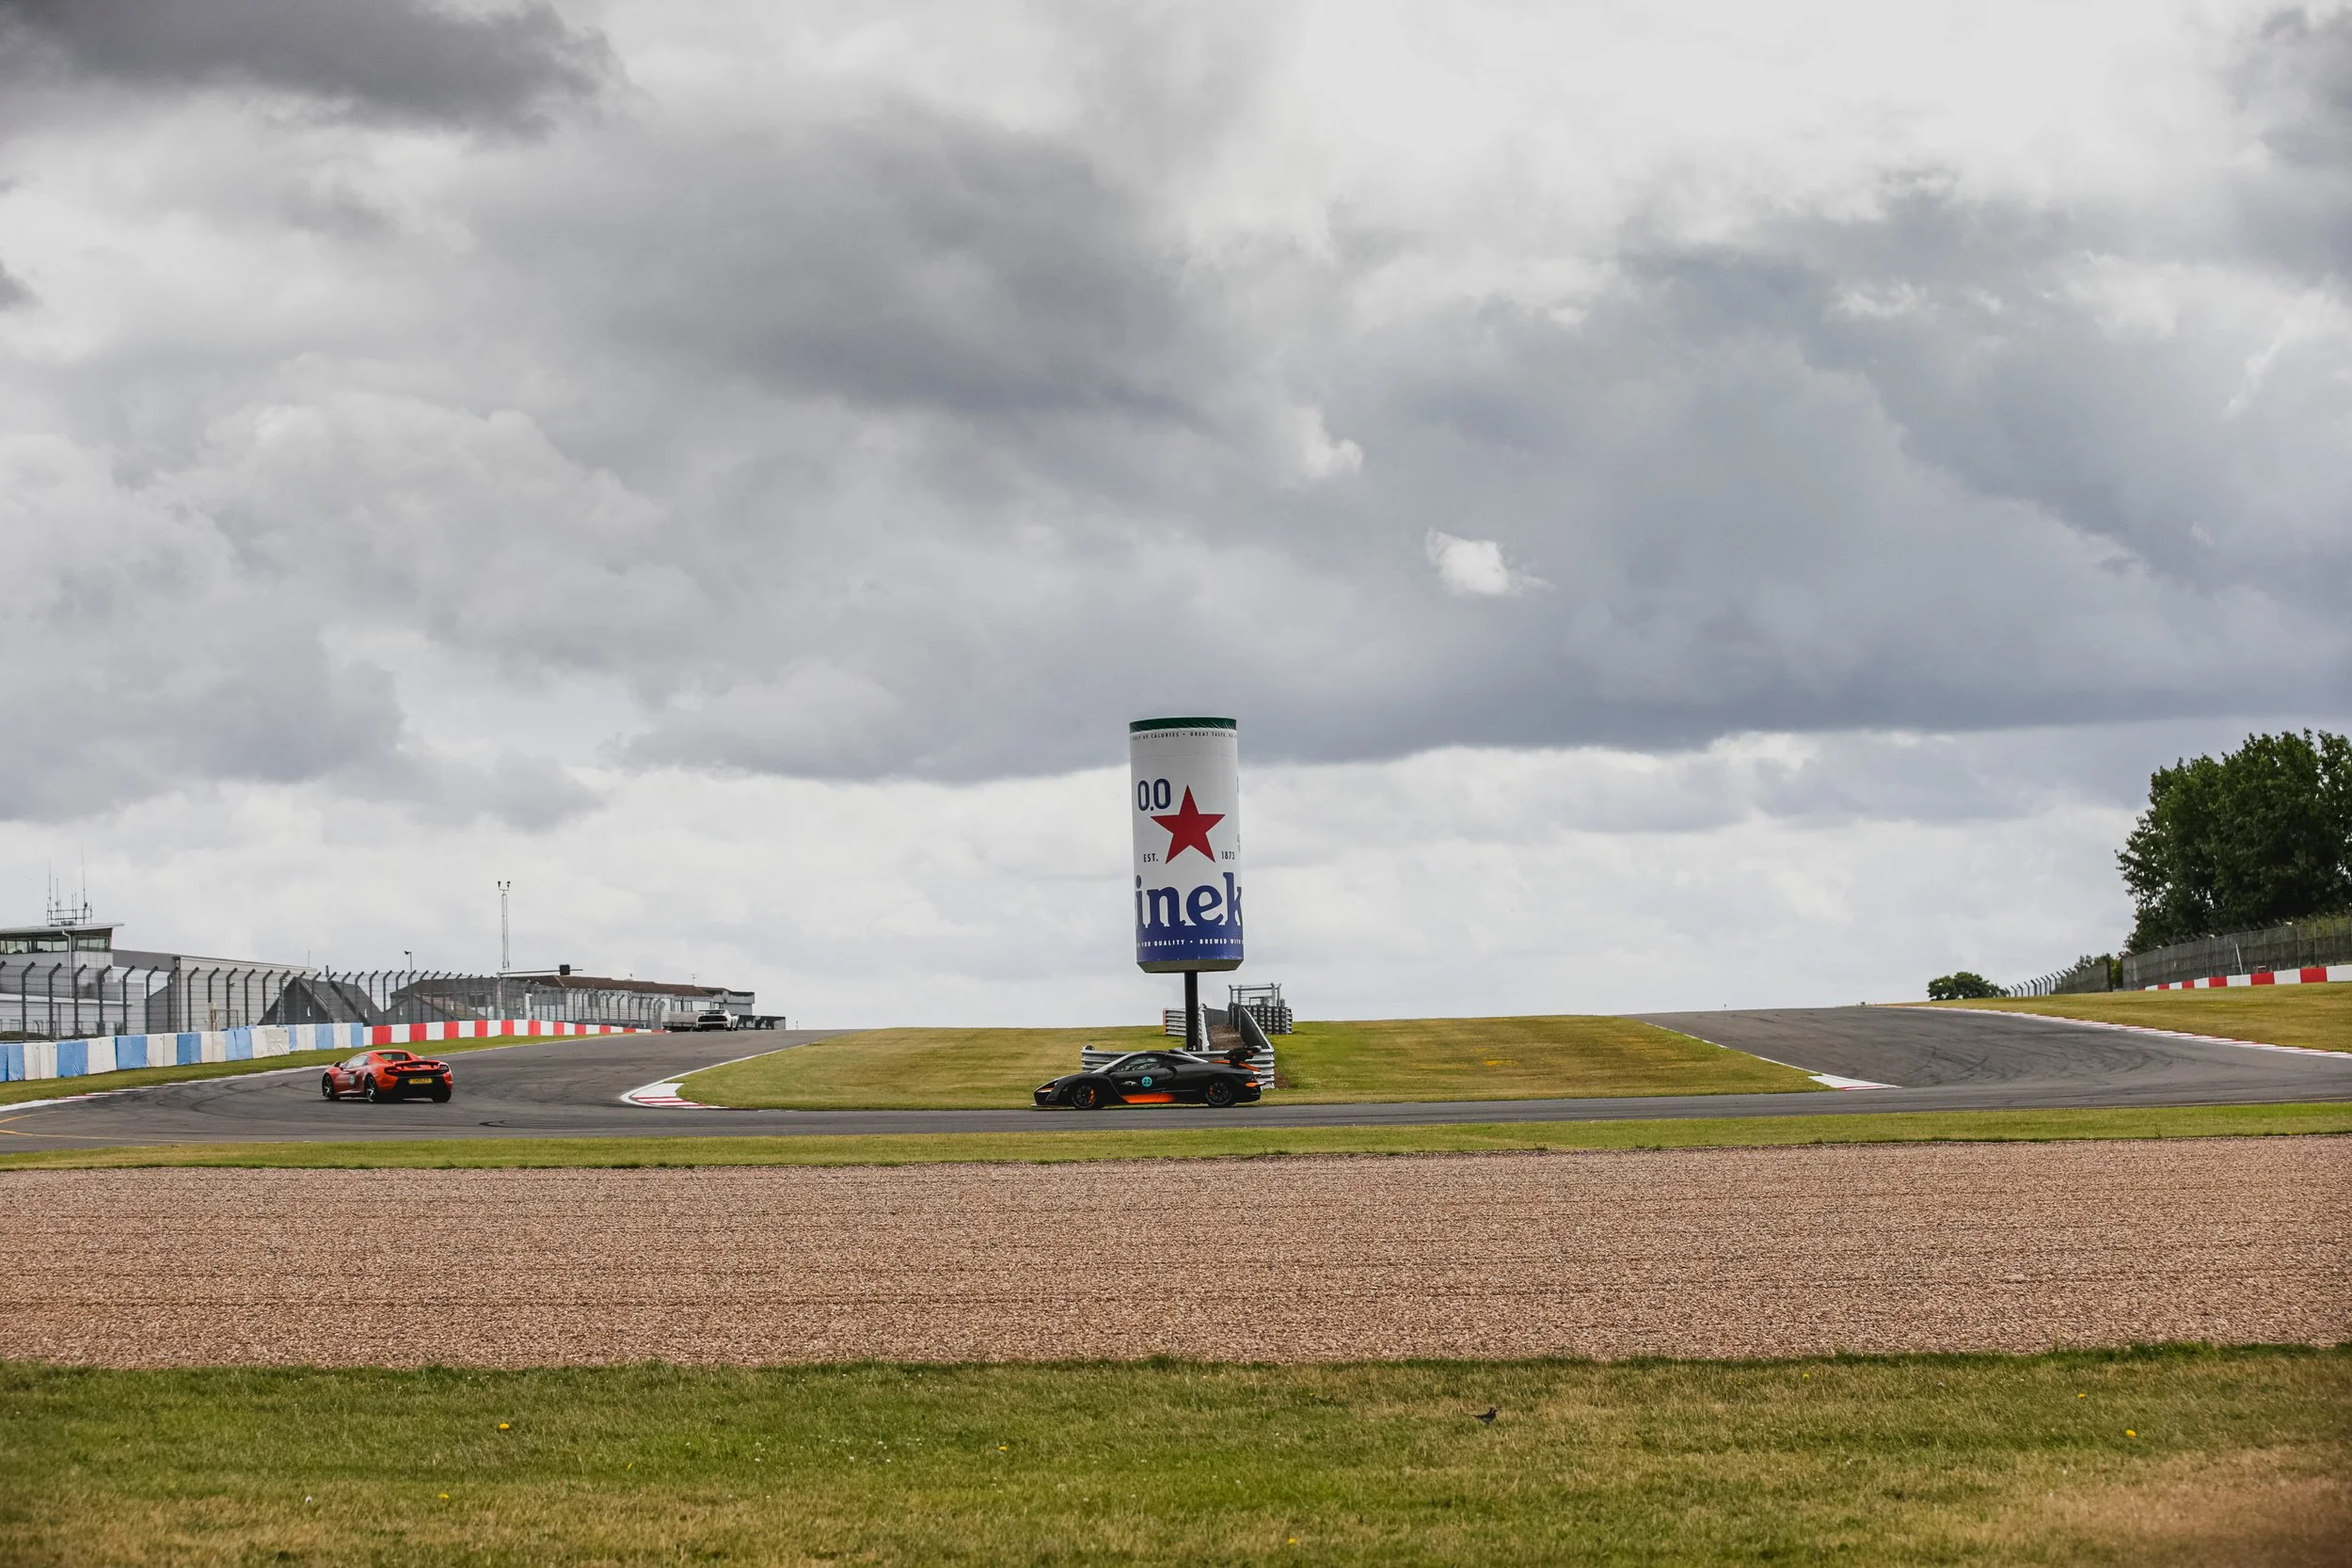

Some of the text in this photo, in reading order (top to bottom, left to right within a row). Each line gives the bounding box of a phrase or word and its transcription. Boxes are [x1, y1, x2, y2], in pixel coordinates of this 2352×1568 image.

[1137, 778, 1171, 812] 0.0
[1143, 853, 1159, 863] EST.
[1221, 851, 1235, 860] 1873
